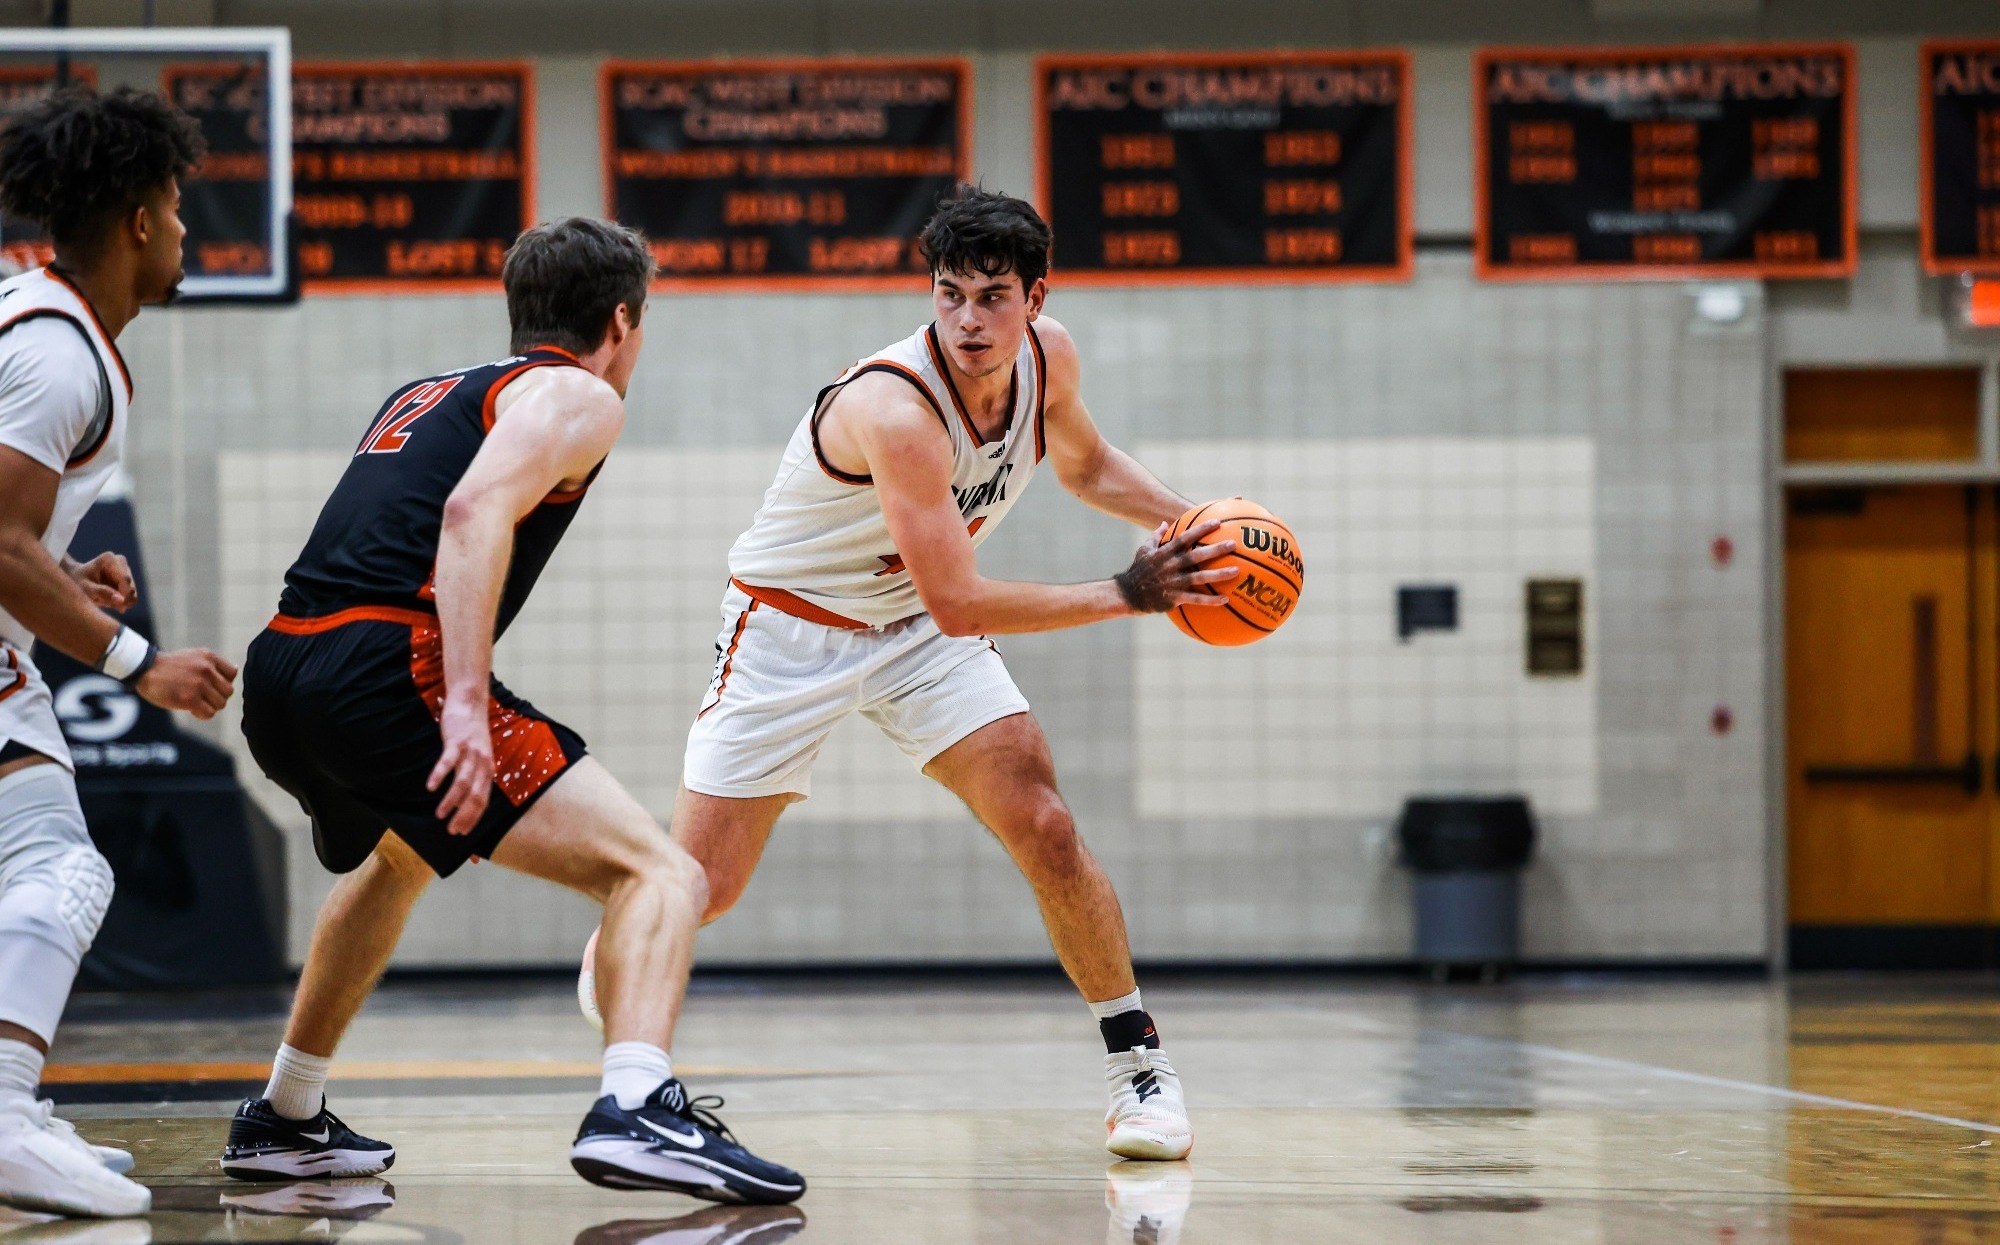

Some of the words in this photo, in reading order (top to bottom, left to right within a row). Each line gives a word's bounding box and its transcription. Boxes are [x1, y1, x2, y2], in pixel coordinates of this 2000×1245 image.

[684, 106, 888, 138] CHAMPIONS
[387, 239, 480, 274] LOST
[808, 235, 902, 269] LOST
[355, 375, 465, 457] 12
[1236, 573, 1292, 617] NCAA
